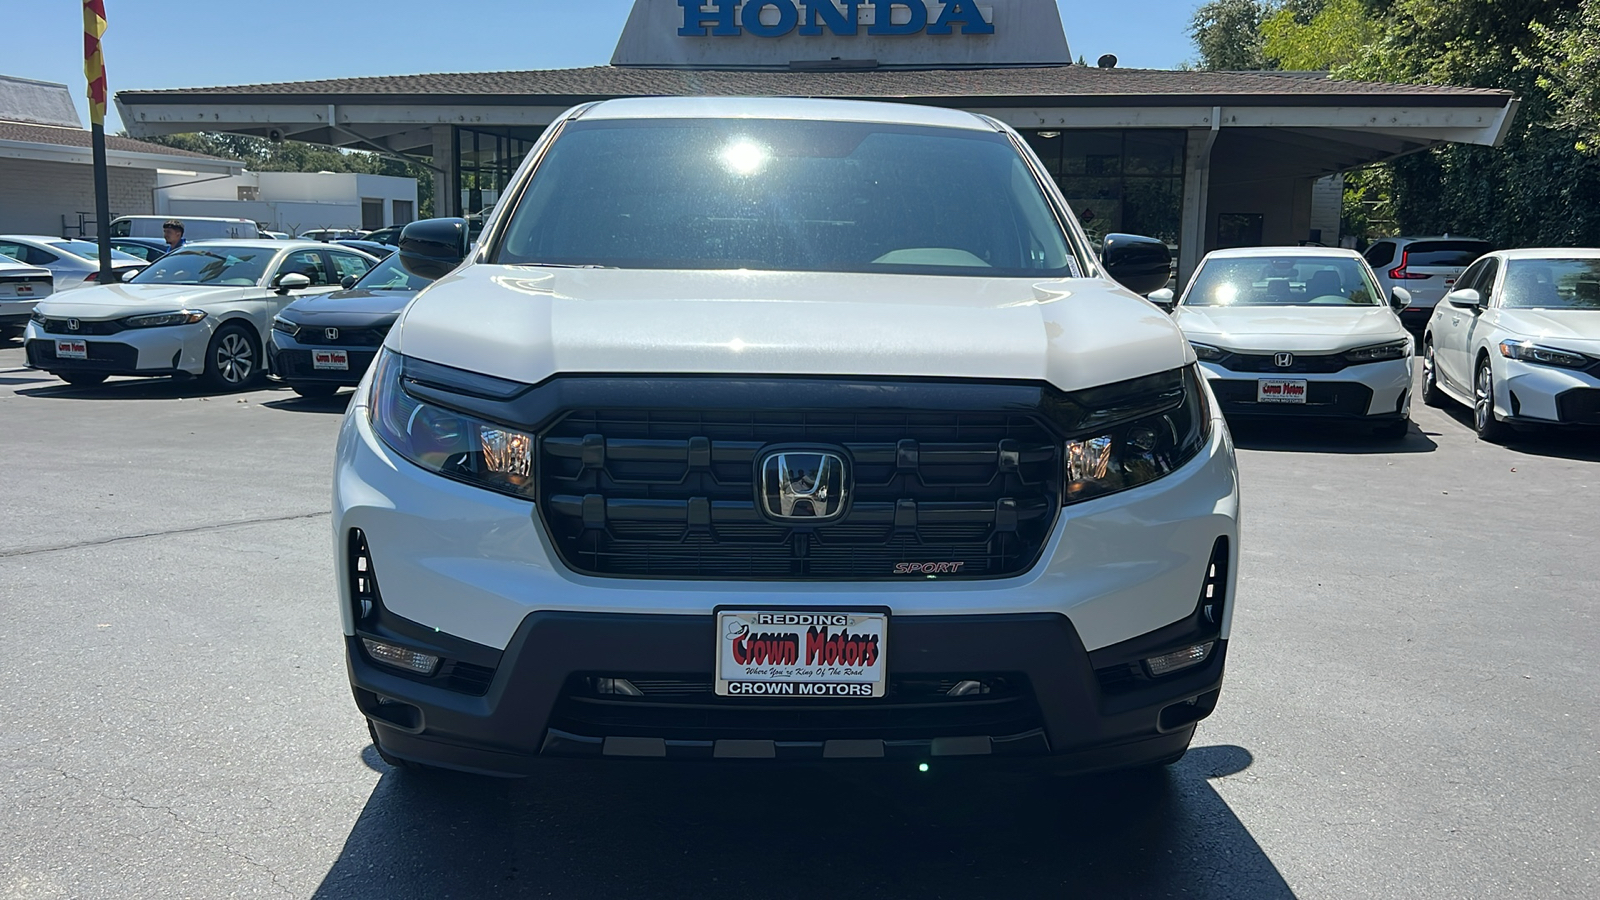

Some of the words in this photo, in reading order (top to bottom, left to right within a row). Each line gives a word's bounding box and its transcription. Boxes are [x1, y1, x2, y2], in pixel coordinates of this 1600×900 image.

[678, 0, 994, 37] HONDA
[893, 562, 964, 573] SPORT
[759, 615, 847, 625] REDDING
[732, 625, 799, 666] Crown
[805, 626, 878, 667] Motors
[745, 667, 768, 675] Where
[769, 667, 793, 678] You're
[795, 668, 813, 677] King
[815, 668, 825, 677] Of
[828, 668, 841, 676] The
[729, 682, 794, 694] CROWN
[799, 683, 872, 695] MOTORS
